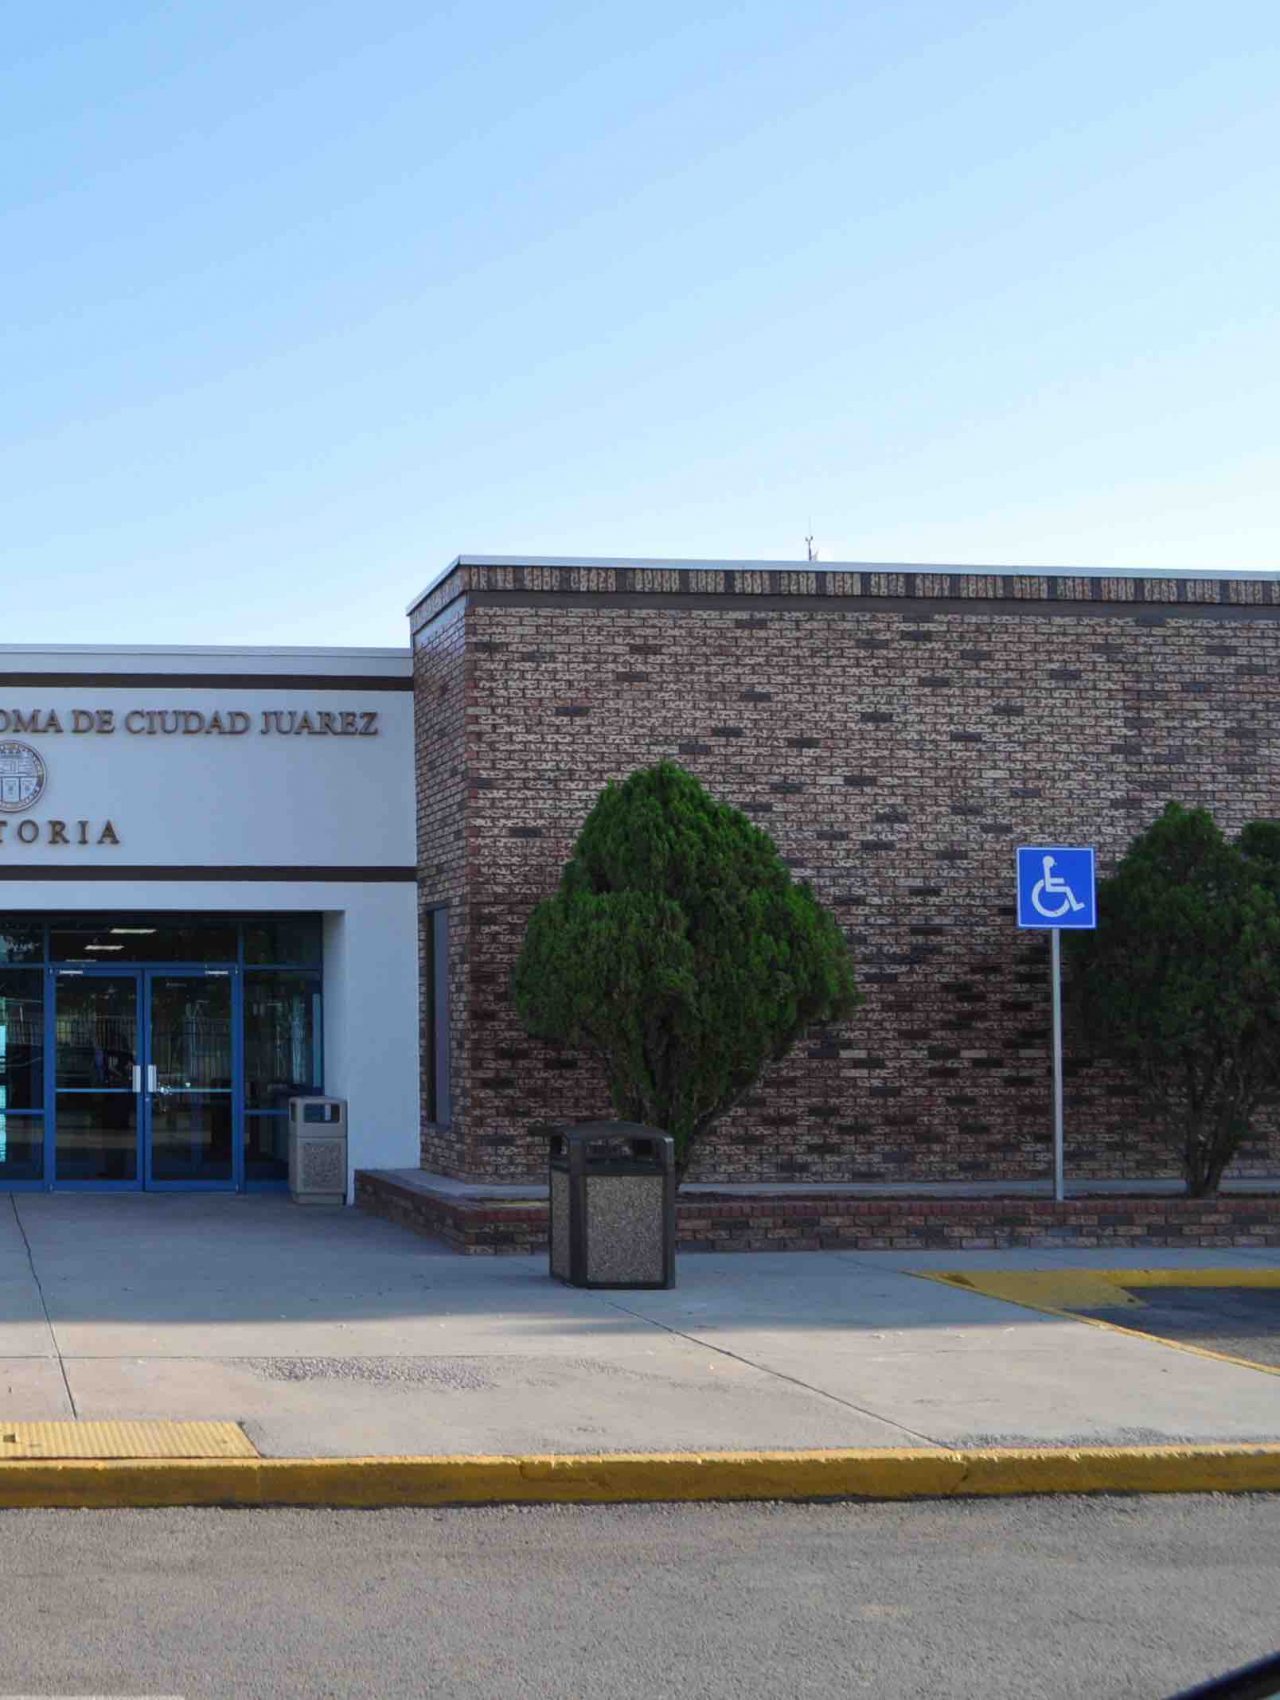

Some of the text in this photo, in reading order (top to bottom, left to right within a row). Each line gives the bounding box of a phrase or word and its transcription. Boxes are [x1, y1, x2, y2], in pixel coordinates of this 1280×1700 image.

[71, 709, 116, 735] DE
[125, 710, 252, 736] CIUDAD
[260, 711, 380, 737] JUAREZ
